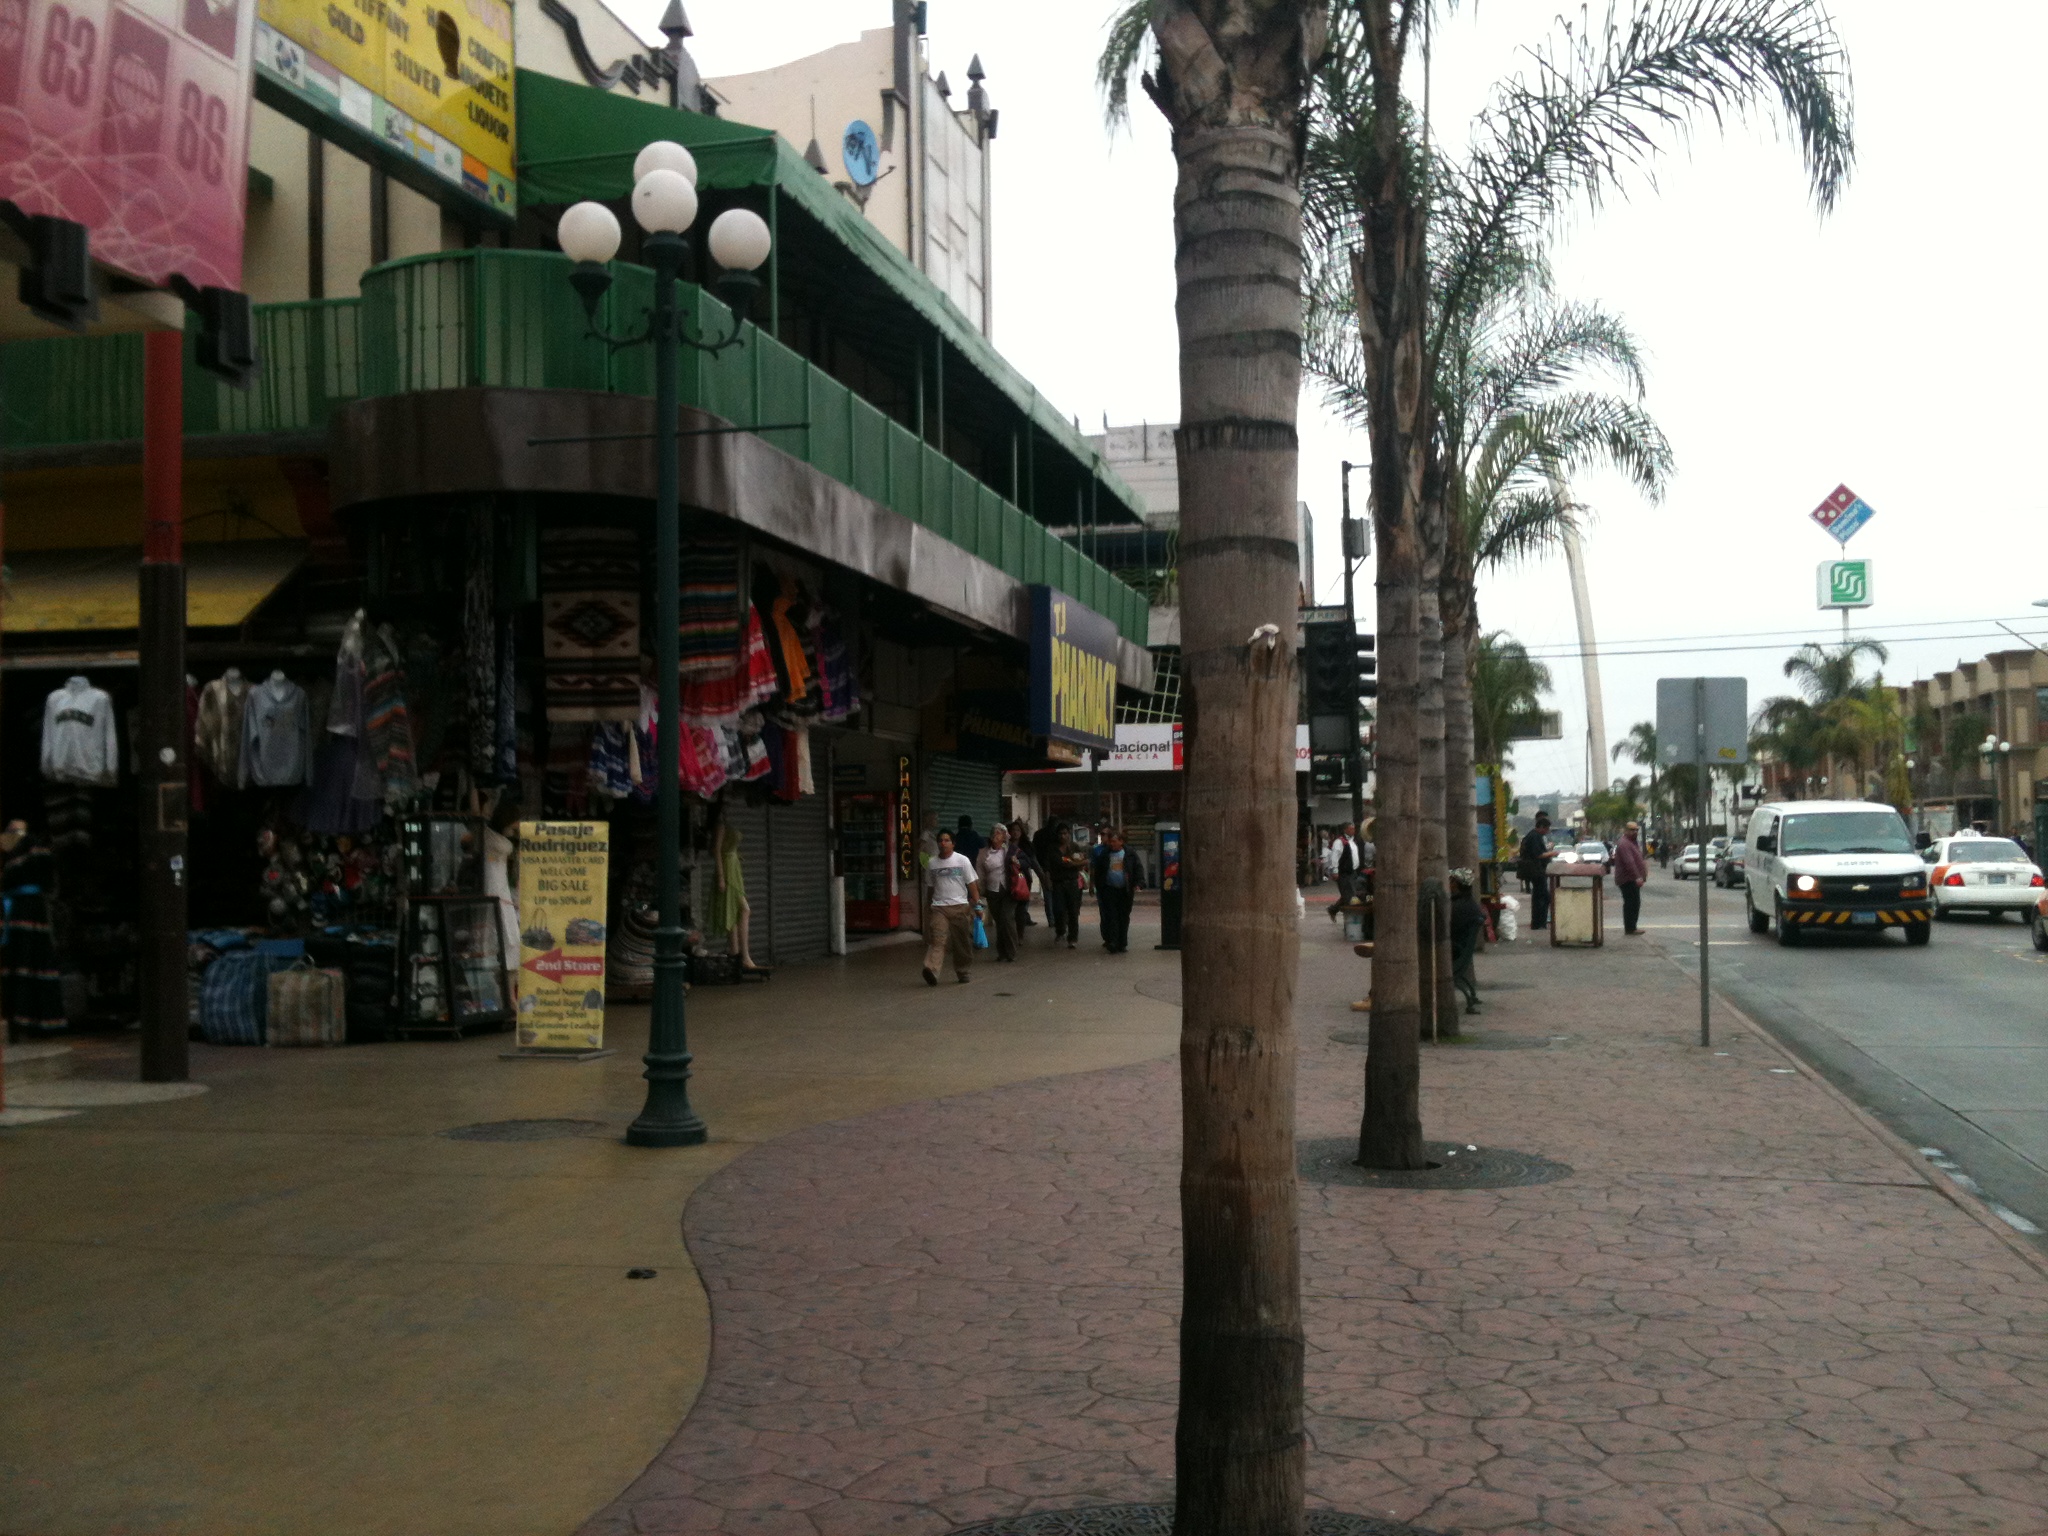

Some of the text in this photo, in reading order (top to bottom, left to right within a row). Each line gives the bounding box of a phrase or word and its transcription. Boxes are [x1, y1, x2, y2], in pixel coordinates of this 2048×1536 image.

[326, 3, 364, 45] GOLD
[40, 4, 95, 108] 63
[394, 48, 441, 97] SILVER
[467, 36, 508, 82] CRAFTS
[467, 99, 510, 143] LIQUOR
[1053, 602, 1066, 635] TJ
[1052, 636, 1117, 739] PHARMACY
[535, 822, 594, 839] Pasaje
[900, 756, 912, 879] PHARMACY
[520, 838, 608, 855] Rodriguez
[538, 879, 589, 891] BIG SALE
[540, 866, 586, 876] WELCOME
[536, 960, 601, 971] 2nd Store
